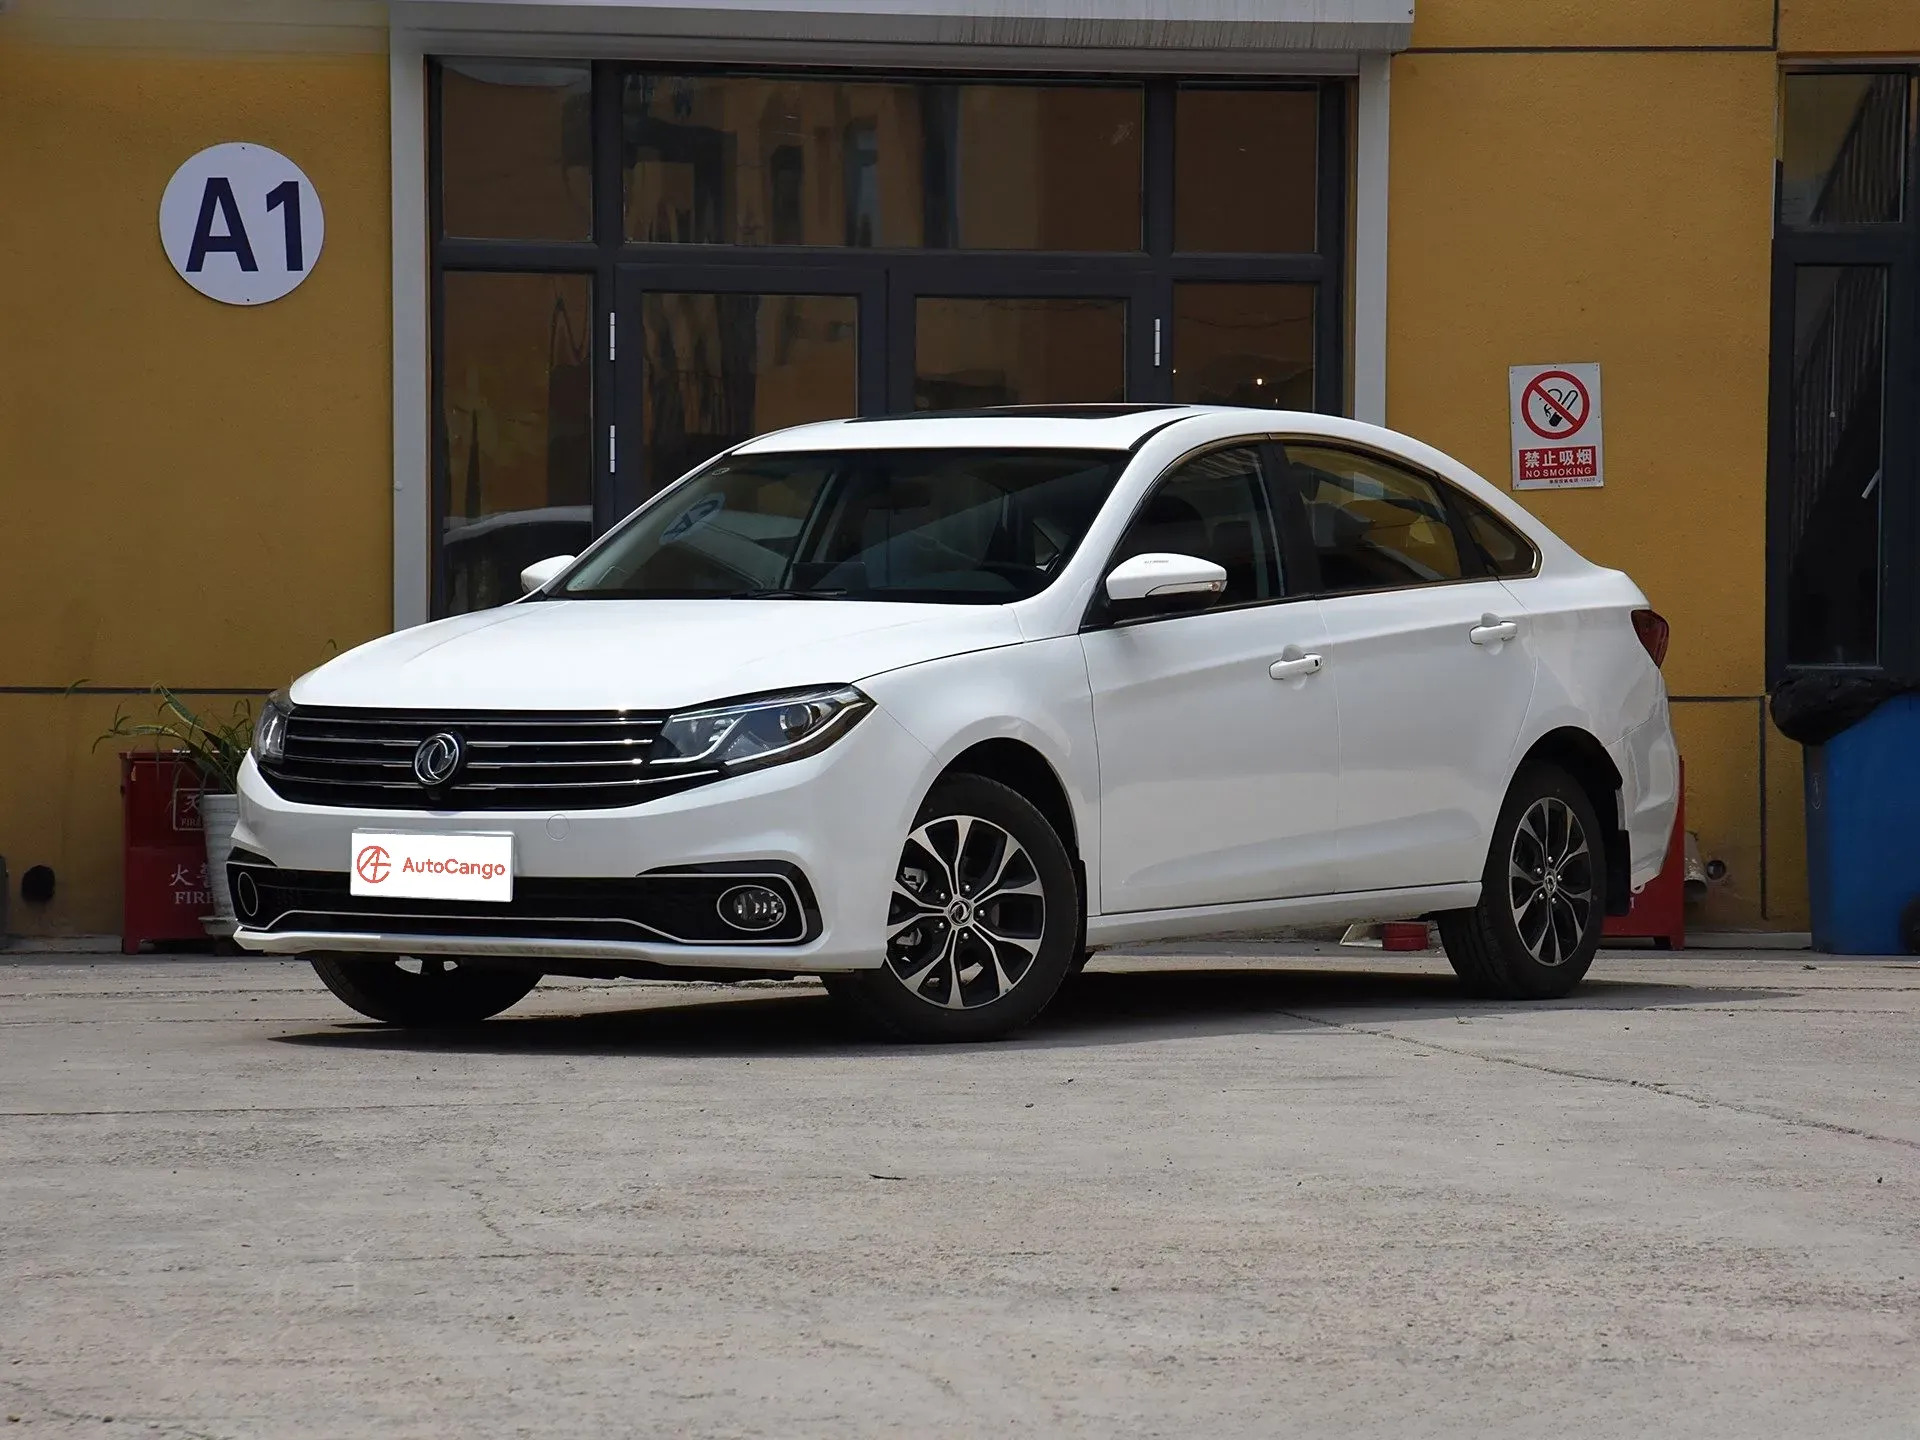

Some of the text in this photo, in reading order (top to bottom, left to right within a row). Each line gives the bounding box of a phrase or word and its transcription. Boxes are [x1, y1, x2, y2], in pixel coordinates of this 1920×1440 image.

[185, 177, 303, 272] A1
[1525, 449, 1592, 468] 禁止吸烟
[1525, 467, 1591, 478] NO SMOKING
